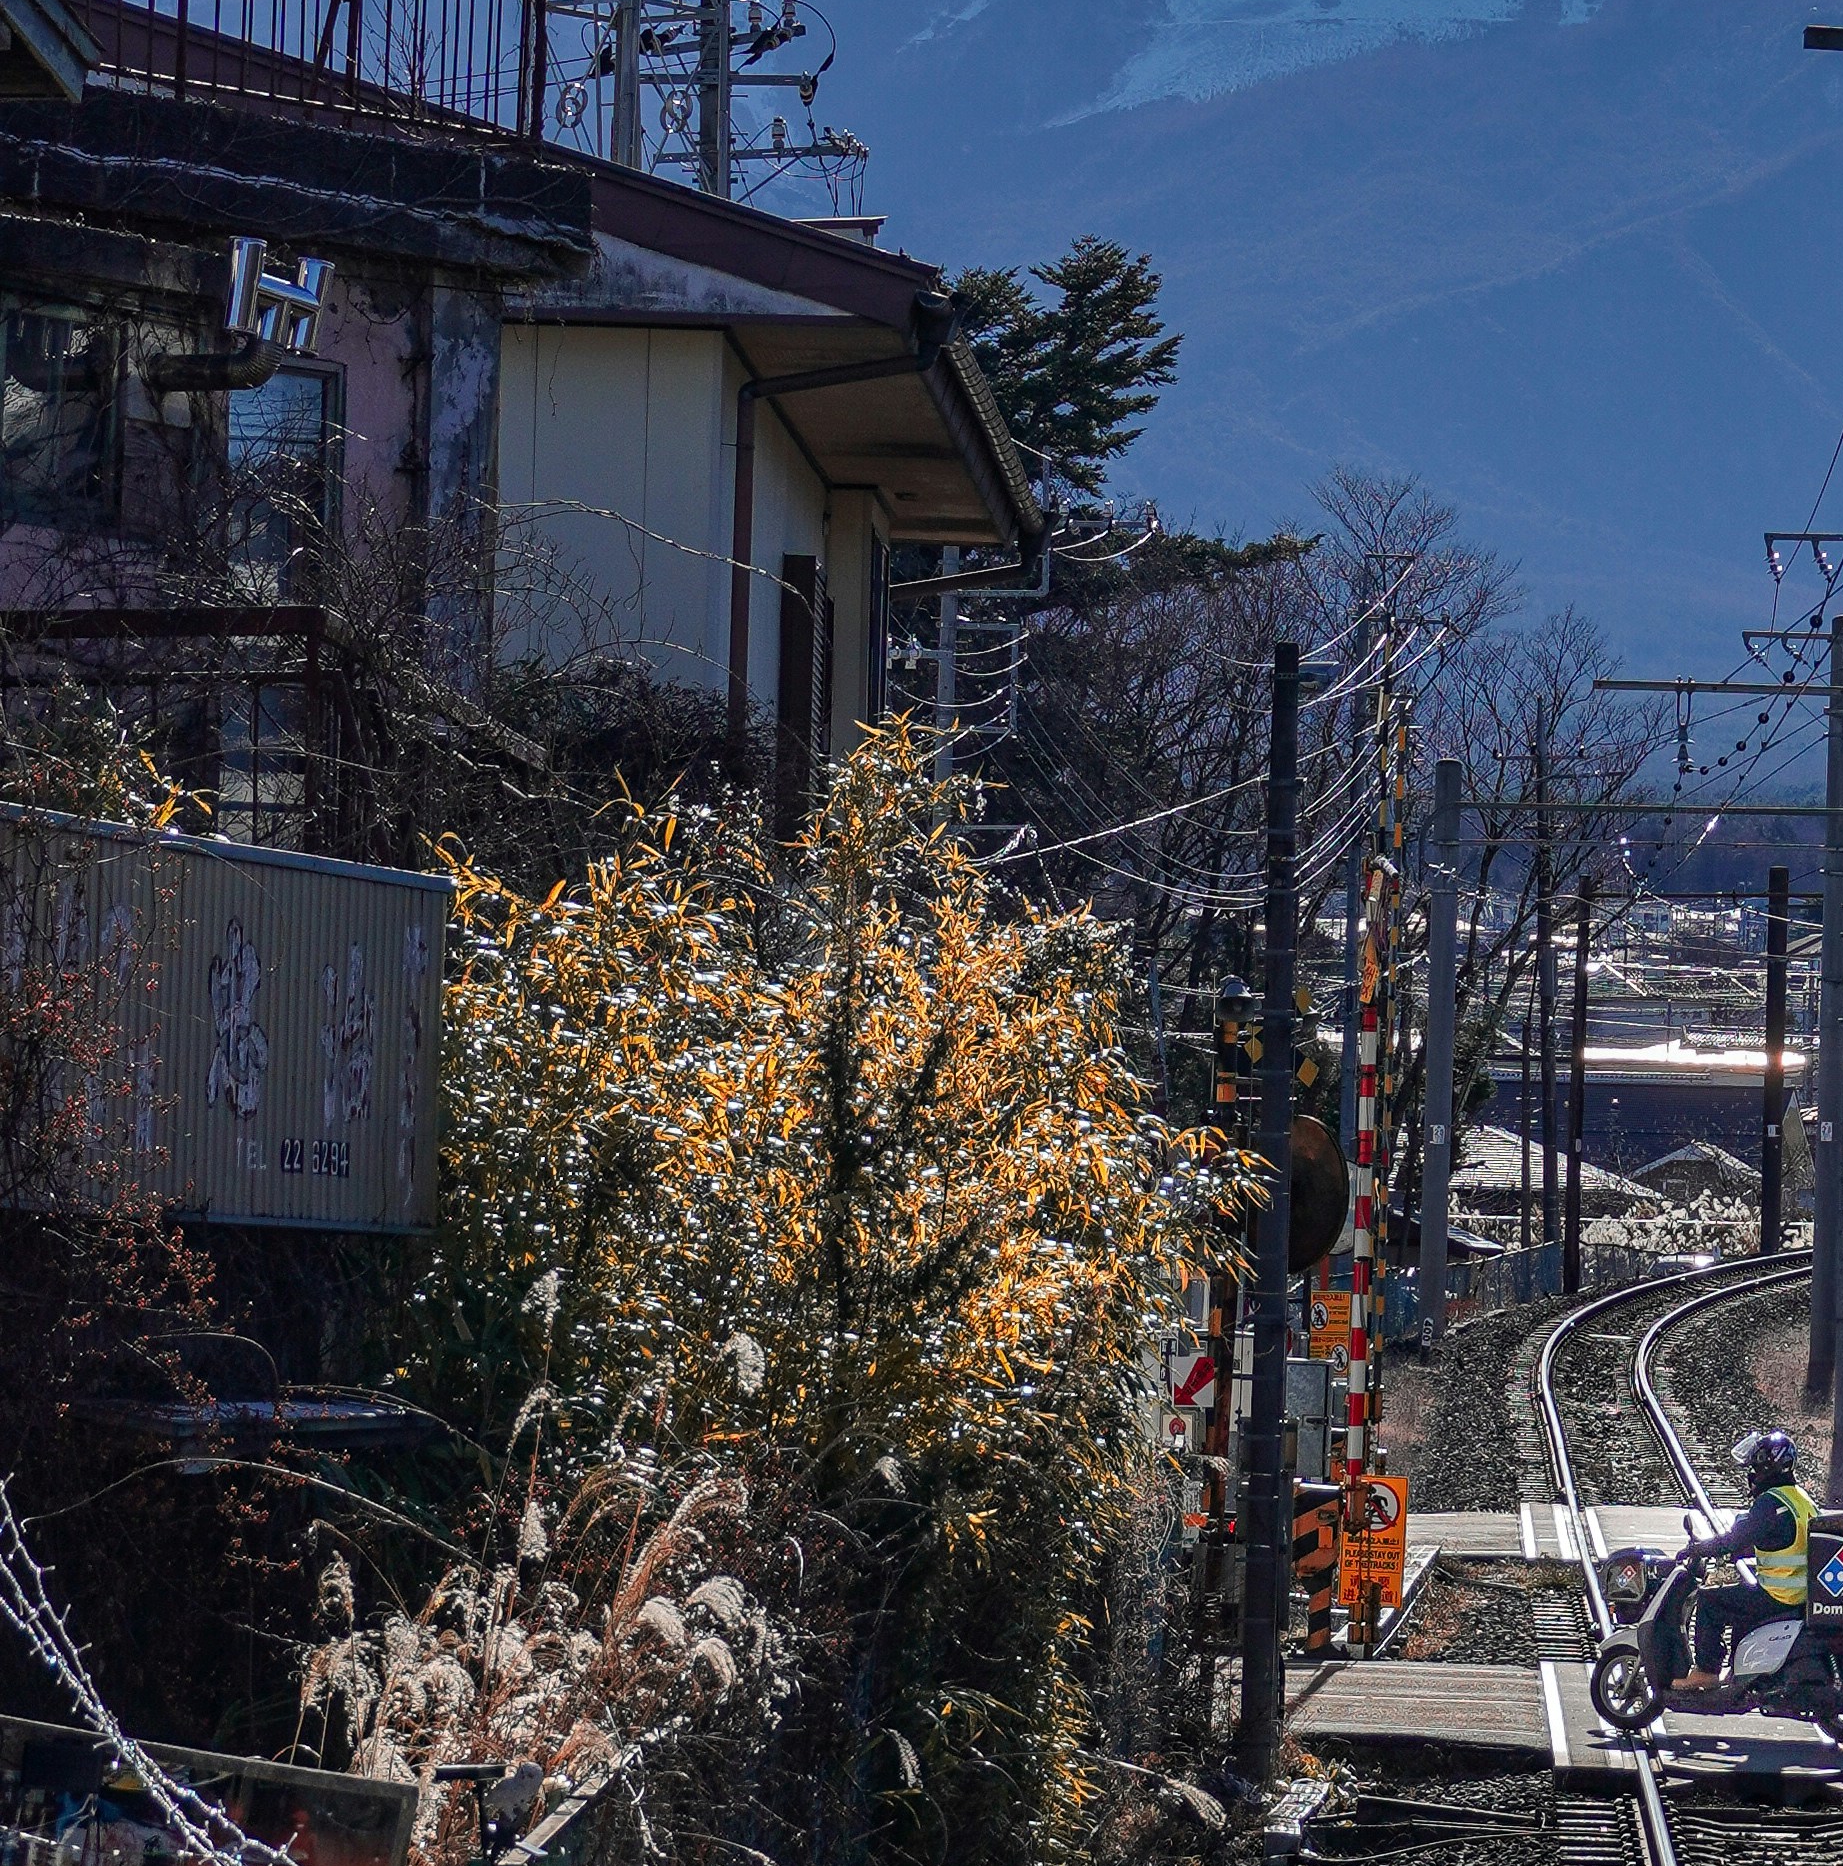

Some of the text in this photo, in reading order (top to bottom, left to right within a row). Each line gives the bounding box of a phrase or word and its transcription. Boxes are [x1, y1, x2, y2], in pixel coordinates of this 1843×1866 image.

[284, 1138, 301, 1170] 22
[312, 1140, 349, 1175] 6294
[1386, 1551, 1401, 1560] OUT
[1344, 1559, 1354, 1568] OF
